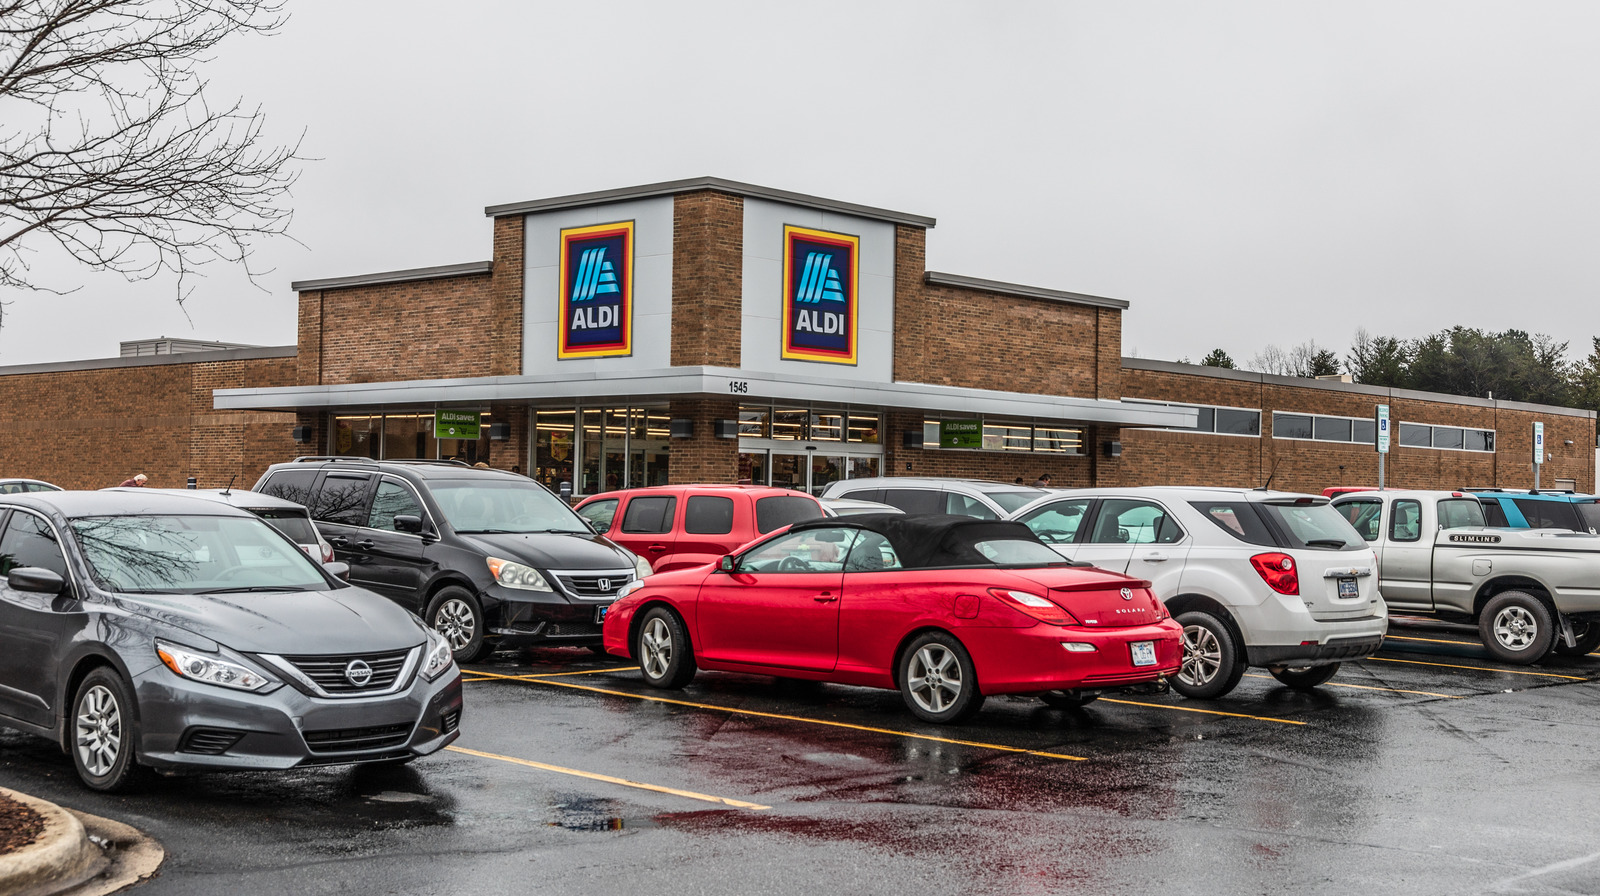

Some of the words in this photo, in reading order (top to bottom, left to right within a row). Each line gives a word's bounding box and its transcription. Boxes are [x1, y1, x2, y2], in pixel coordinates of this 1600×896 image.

[571, 304, 619, 330] ALDI
[795, 309, 844, 335] ALDI
[729, 381, 748, 393] 1545
[442, 412, 456, 420] ALDI
[1454, 535, 1496, 543] SLIMLINE
